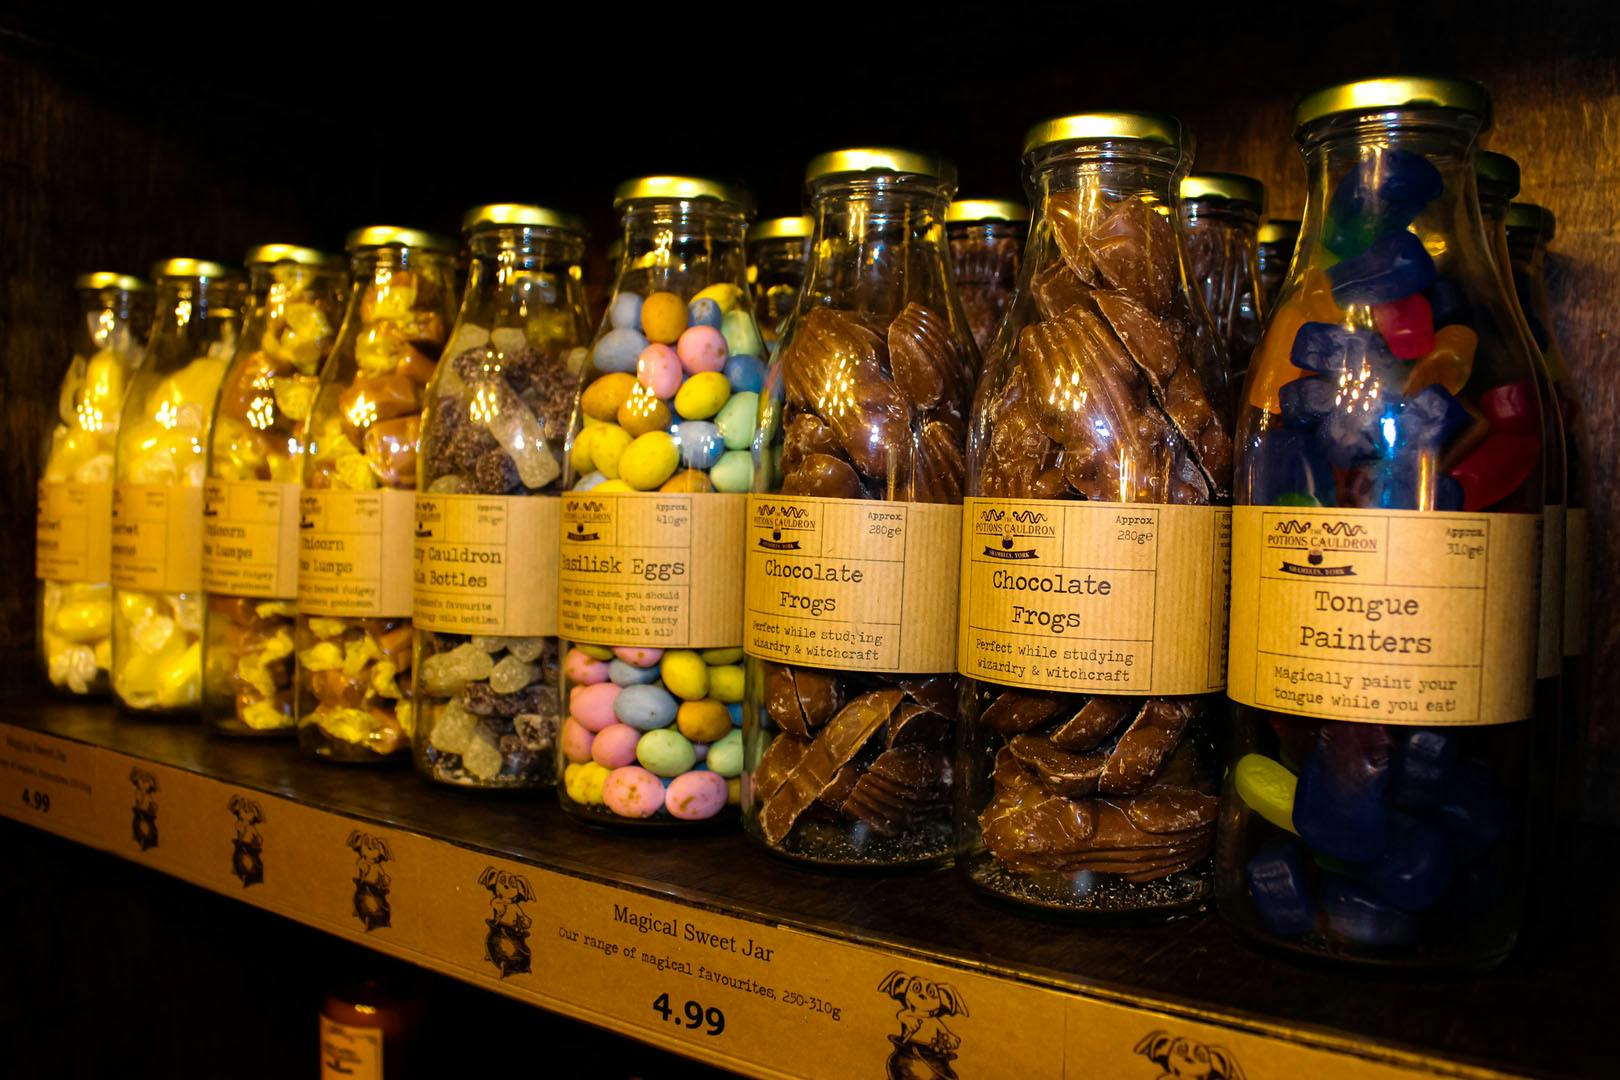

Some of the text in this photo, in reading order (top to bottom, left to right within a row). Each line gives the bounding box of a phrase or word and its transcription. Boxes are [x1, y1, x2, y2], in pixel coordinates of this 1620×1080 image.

[774, 517, 816, 529] CAULDRON
[976, 522, 1056, 536] POTIONS CAULDRON
[1116, 514, 1155, 526] Approx.
[1268, 535, 1377, 549] POTIONS CAULDRON
[428, 546, 502, 564] Cauldron
[562, 554, 685, 581] asilisk Eggs
[429, 570, 488, 588] Bottles
[765, 559, 863, 583] Chocolate
[992, 570, 1111, 596] Chocolate
[625, 592, 642, 601] you
[645, 591, 679, 600] should
[639, 603, 679, 612] however
[779, 591, 836, 616] Frogs
[1315, 590, 1419, 621] Tongue
[784, 625, 816, 638] while
[1012, 605, 1081, 633] Frogs
[753, 636, 880, 661] wizardry & witchcraft
[976, 638, 1134, 667] Perfect while studying
[1300, 626, 1432, 654] Painters
[977, 658, 1130, 682] wizardry & witchcraft
[1274, 665, 1457, 694] Magically paint your
[1274, 687, 1323, 706] tongue
[1331, 693, 1380, 710] while
[1388, 699, 1419, 714] you
[22, 788, 50, 813] 4.99
[613, 904, 774, 962] Magical Sweet Jar
[559, 926, 841, 1021] Our range of magical favourites, 250-310g
[652, 992, 726, 1036] 4.99
